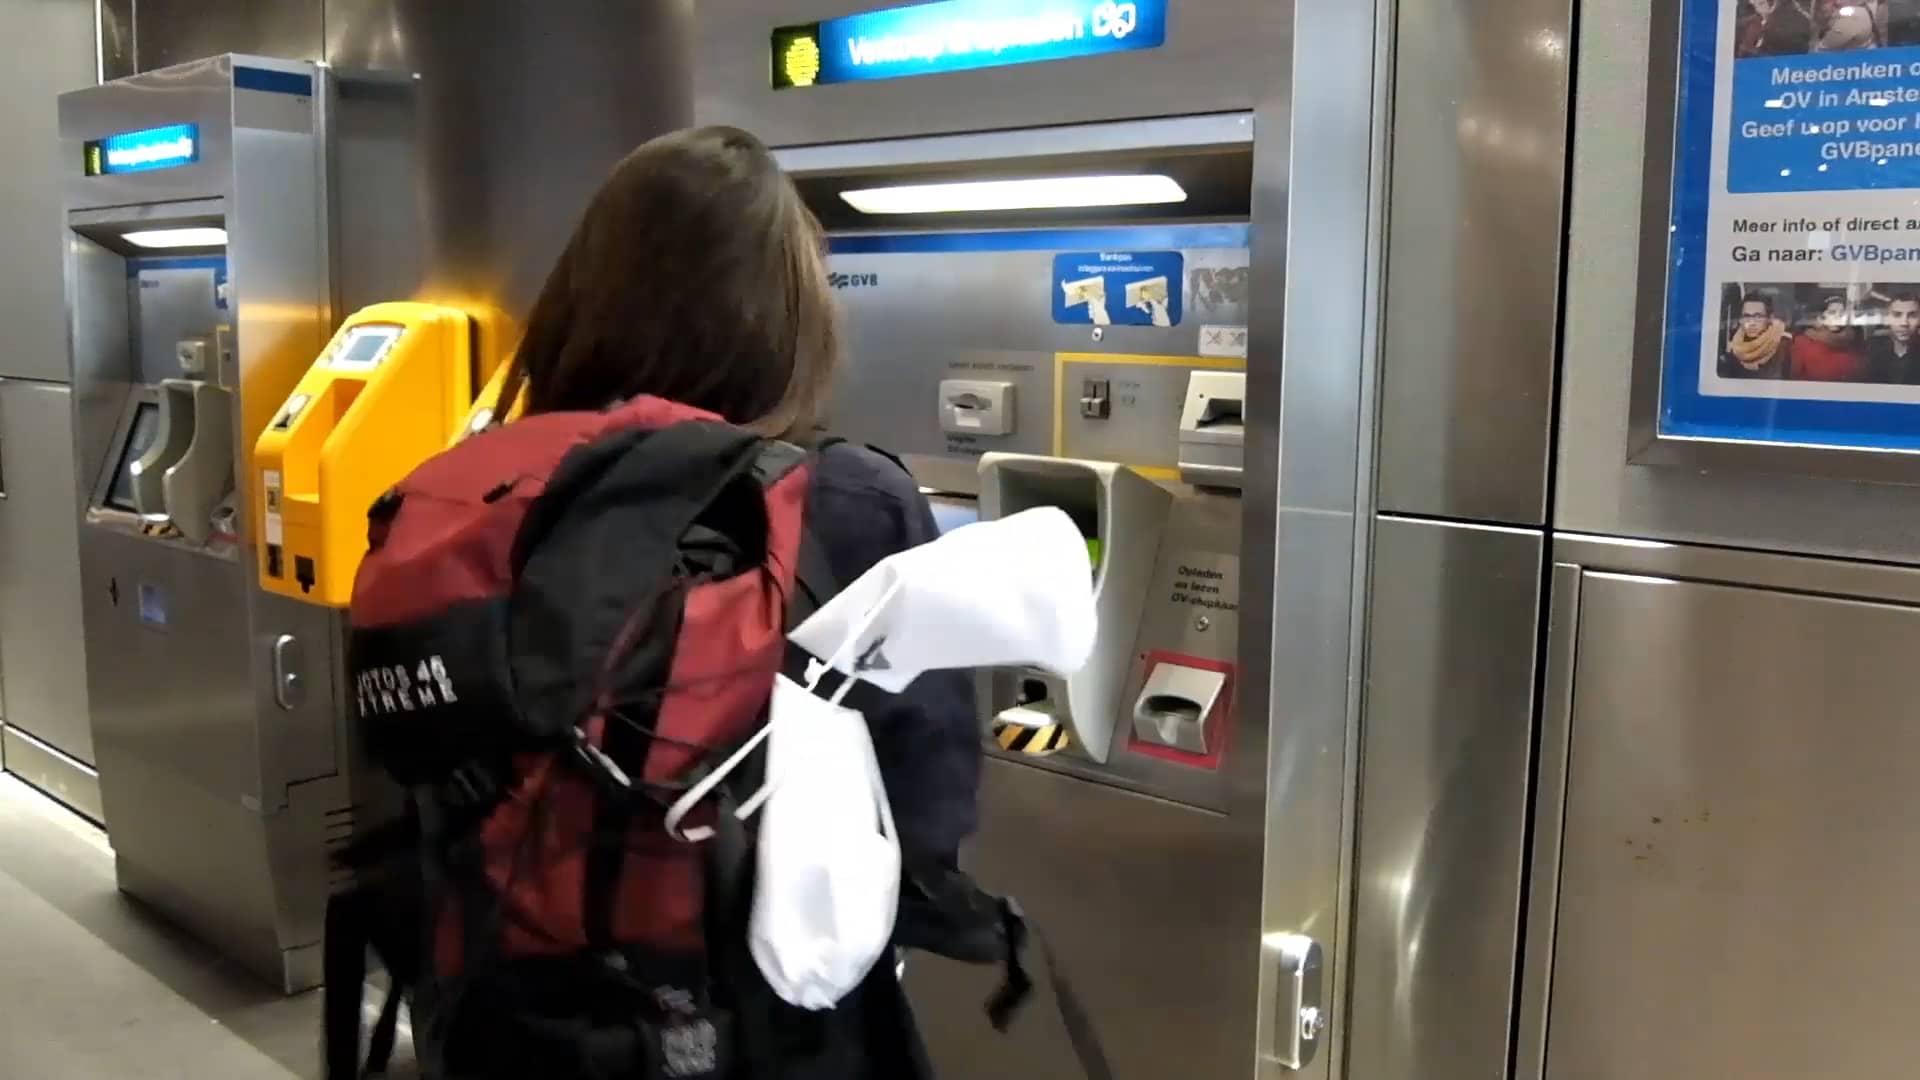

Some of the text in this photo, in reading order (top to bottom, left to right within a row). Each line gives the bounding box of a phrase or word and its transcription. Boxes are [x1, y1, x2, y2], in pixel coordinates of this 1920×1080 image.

[1771, 62, 1901, 85] Meedenken
[1780, 91, 1812, 109] OV
[1818, 90, 1838, 107] in
[1742, 119, 1795, 138] Geef
[1818, 119, 1849, 138] op
[1857, 116, 1907, 133] voor
[1732, 219, 1777, 233] Meer
[1783, 218, 1816, 233] info
[1823, 217, 1841, 231] of
[1846, 217, 1899, 231] direct
[1732, 244, 1920, 264] Ga naar: GVBpan
[851, 273, 878, 287] GVB
